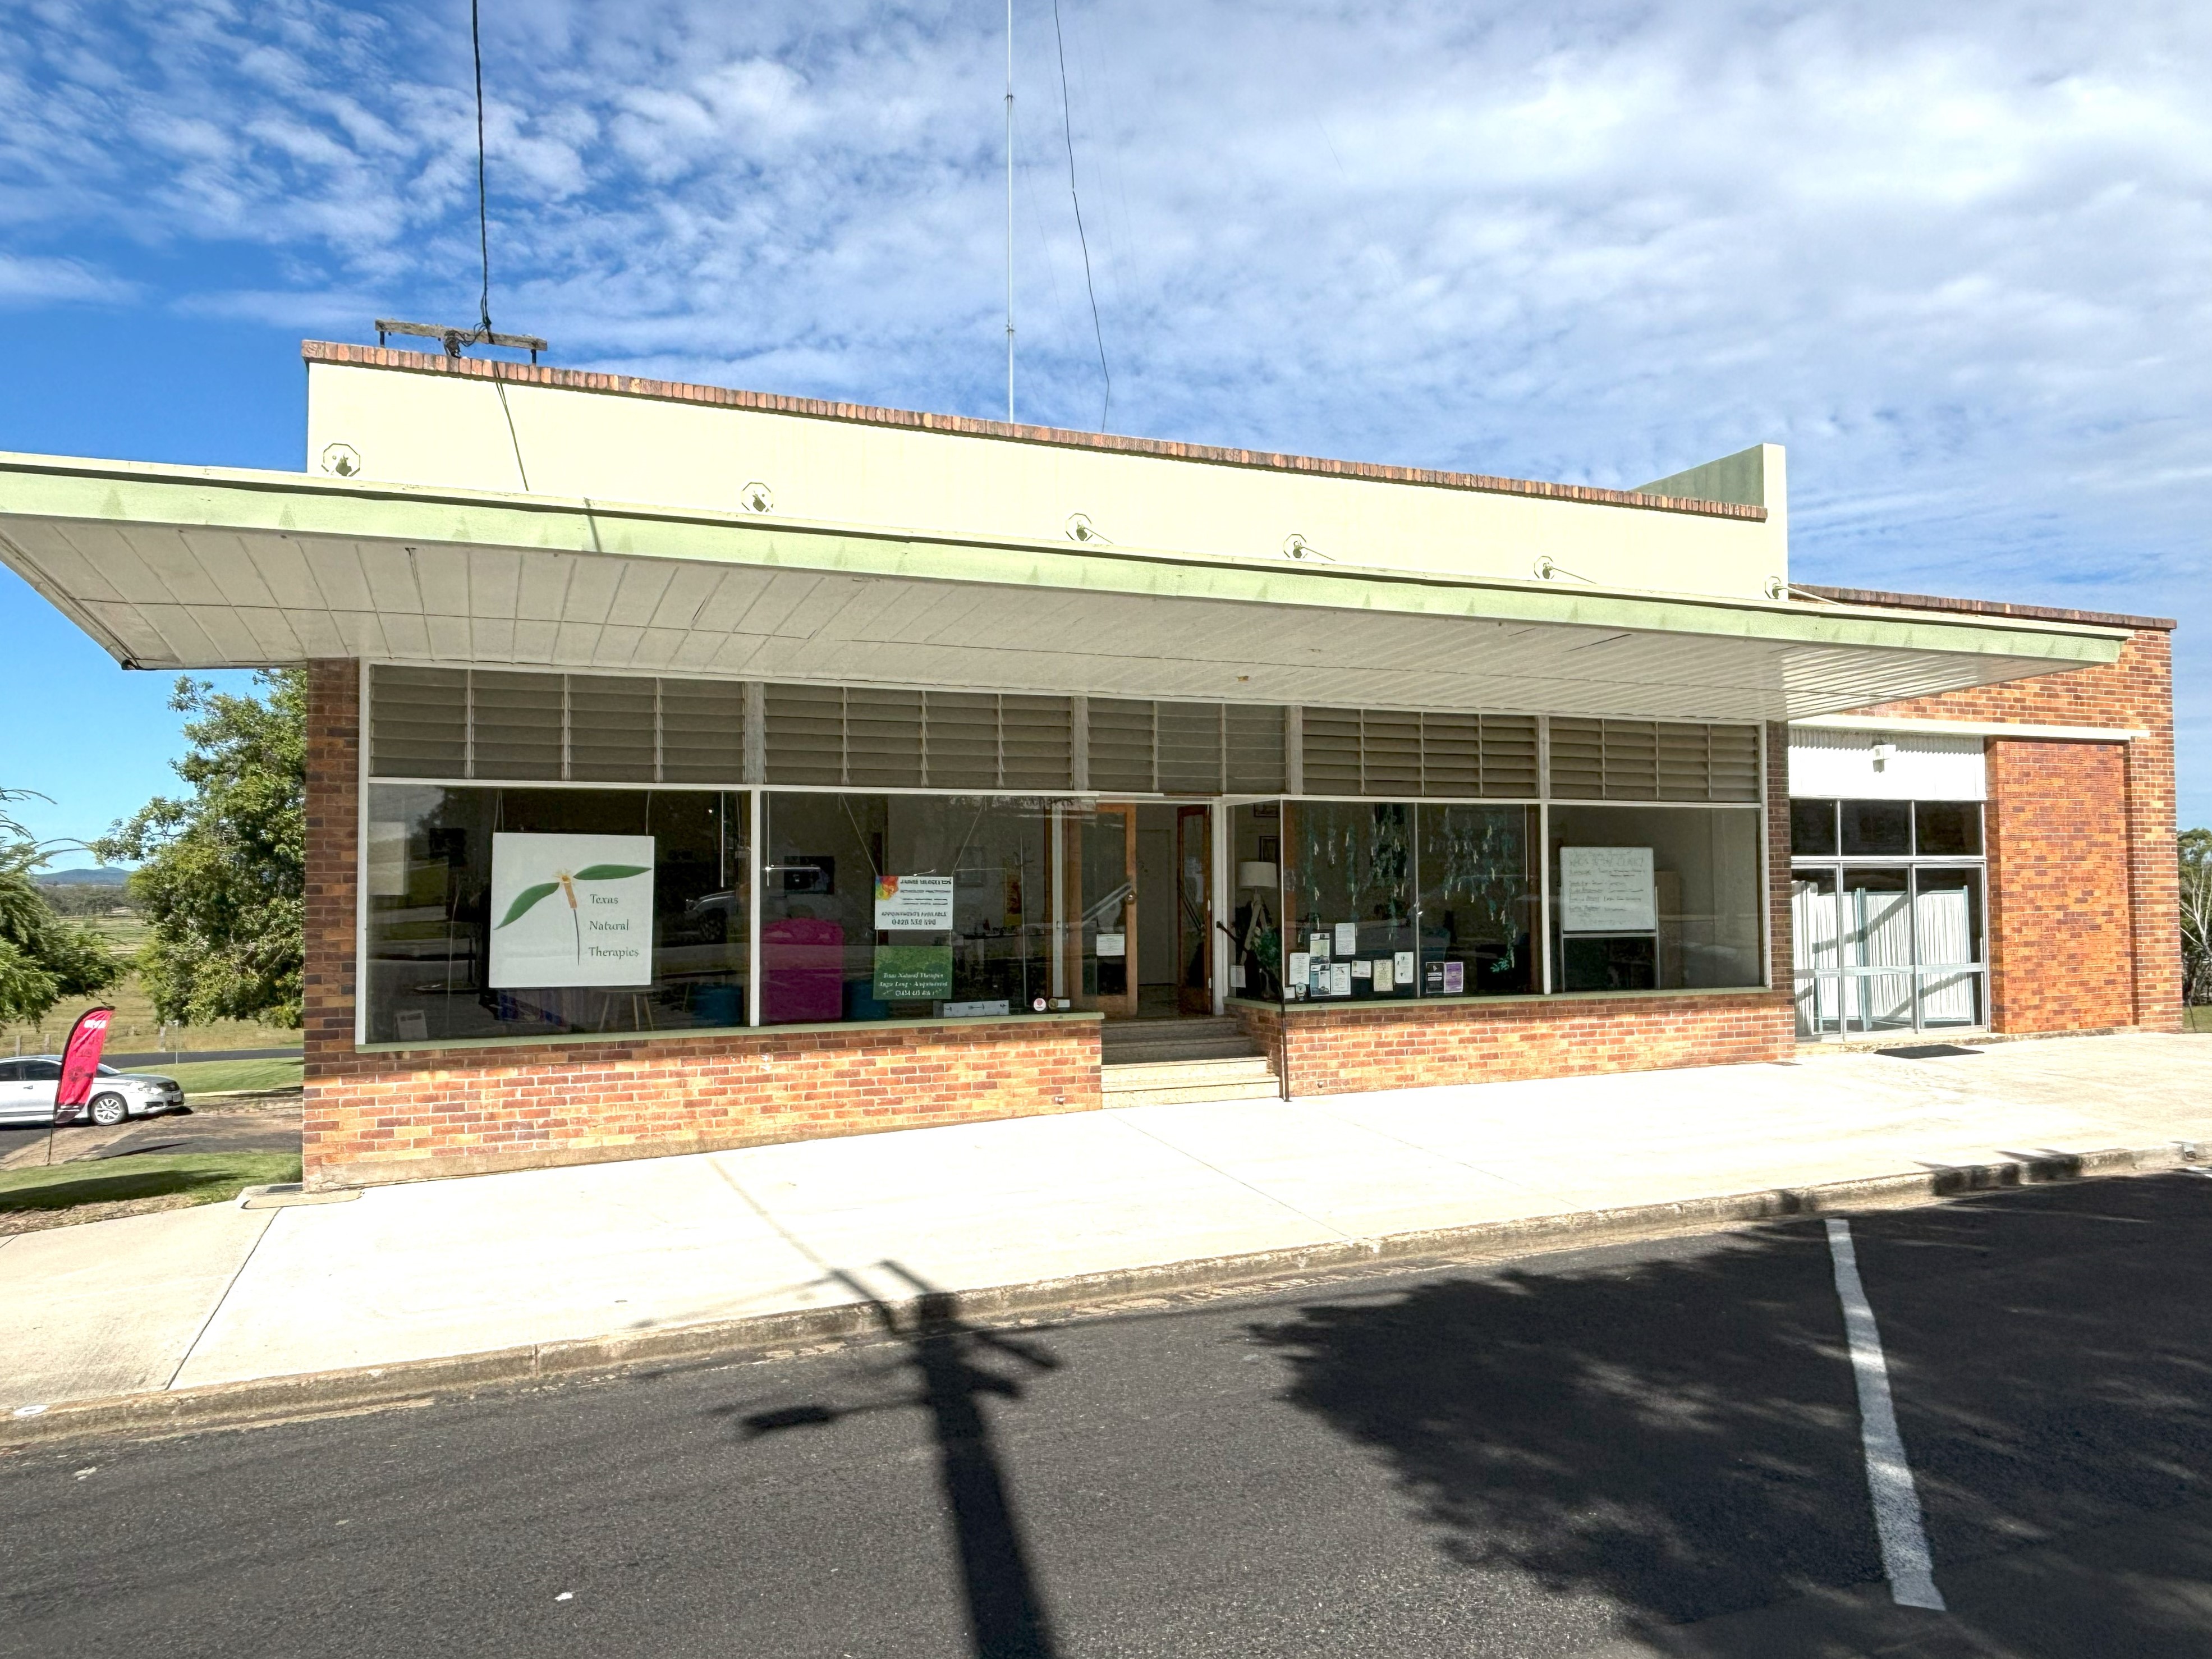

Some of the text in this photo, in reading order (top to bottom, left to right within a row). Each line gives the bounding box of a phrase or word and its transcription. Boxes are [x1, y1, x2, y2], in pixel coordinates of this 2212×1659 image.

[590, 893, 619, 904] Texas
[589, 919, 630, 931] Natural
[588, 946, 640, 960] Therapies
